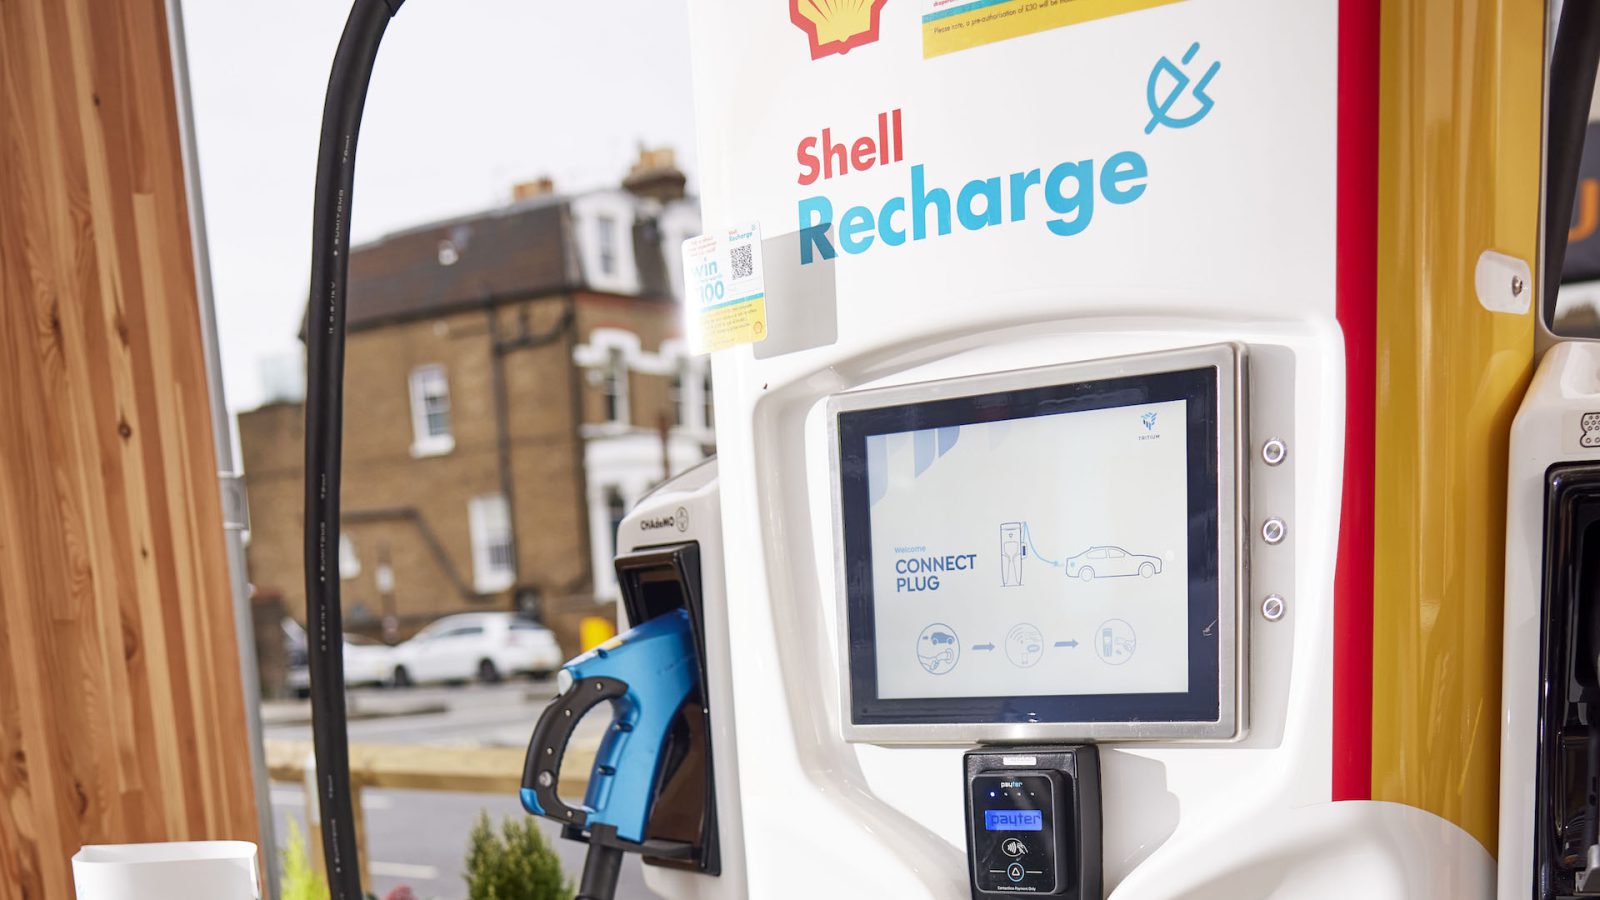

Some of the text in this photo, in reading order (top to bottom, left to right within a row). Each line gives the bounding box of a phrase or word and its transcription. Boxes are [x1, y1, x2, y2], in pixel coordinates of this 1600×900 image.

[933, 25, 951, 34] Please
[1018, 5, 1024, 14] of
[797, 108, 903, 186] Shell
[798, 151, 1148, 265] Recharge
[894, 545, 927, 553] Welcome
[895, 554, 977, 574] CONNECT
[896, 575, 940, 593] PLUG
[991, 812, 1042, 826] payter
